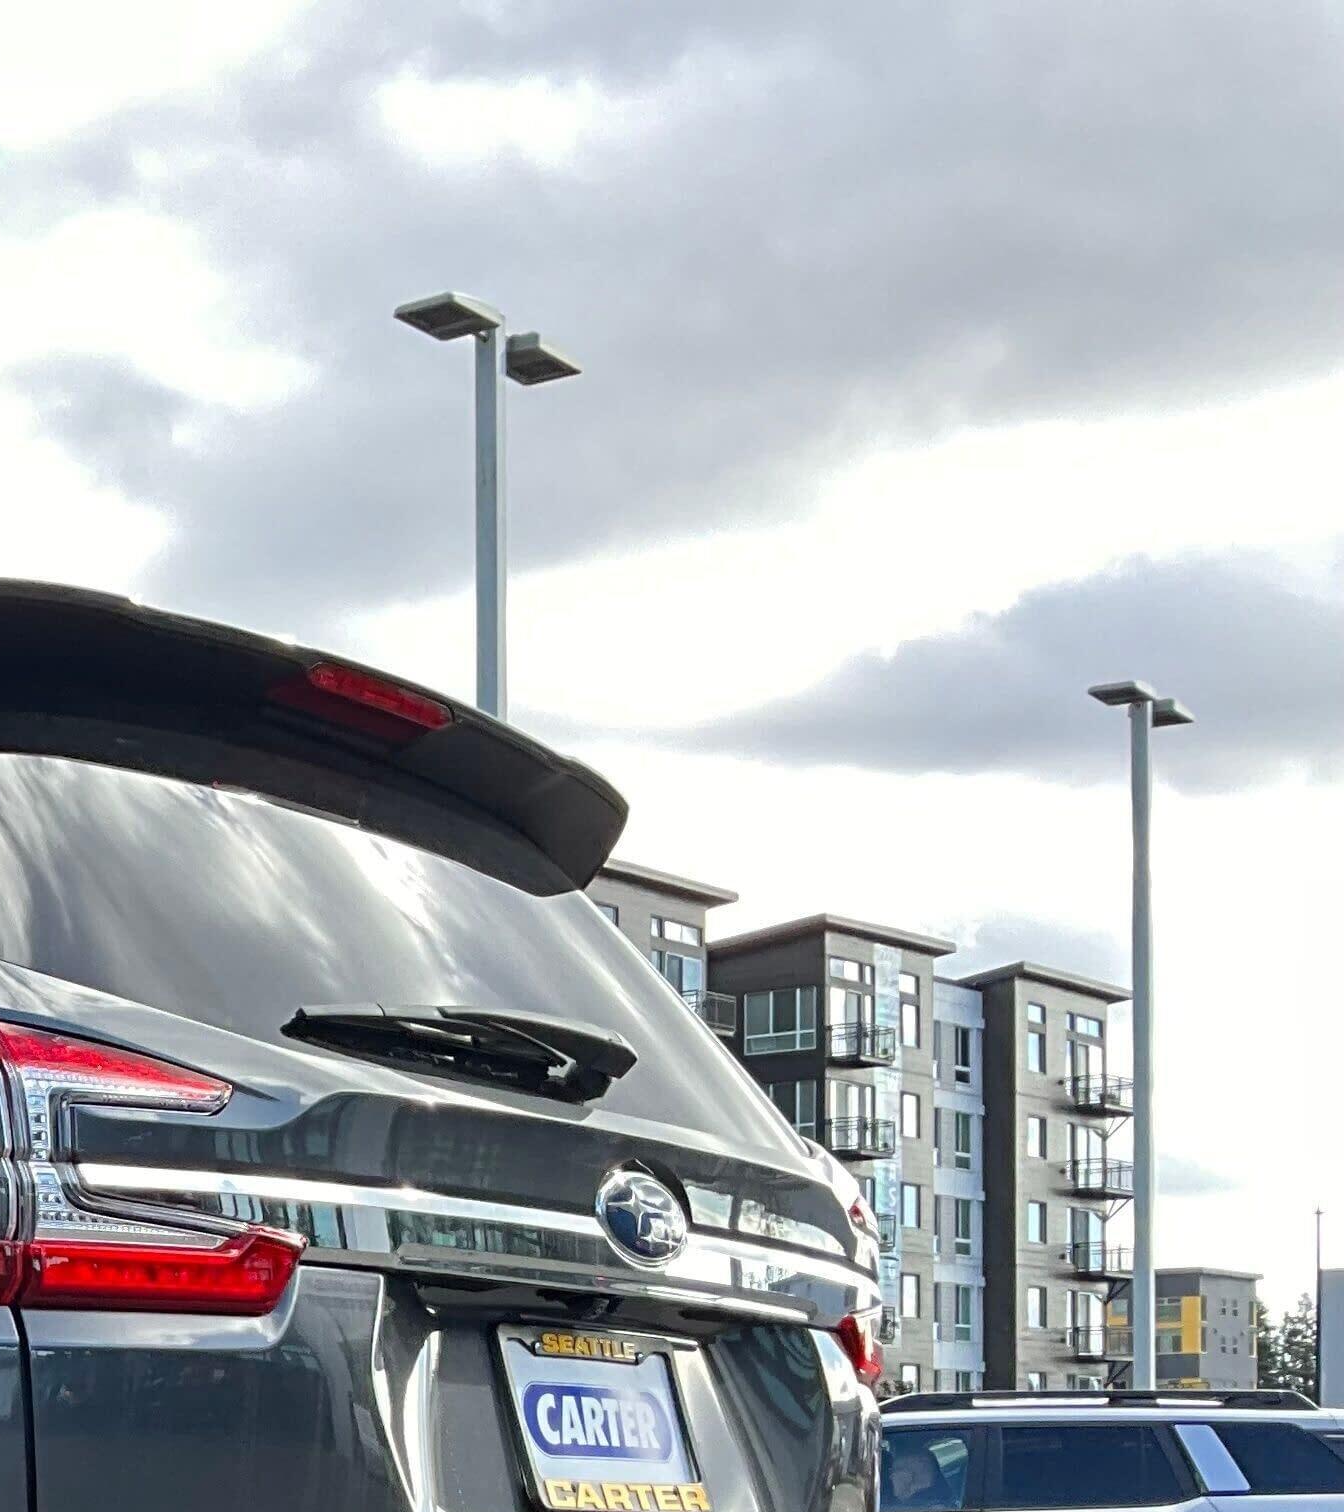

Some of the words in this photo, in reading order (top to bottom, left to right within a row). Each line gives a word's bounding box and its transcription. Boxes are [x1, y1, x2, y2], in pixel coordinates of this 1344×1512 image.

[541, 1332, 636, 1361] SEATTLE
[536, 1393, 661, 1449] CARTER
[544, 1479, 710, 1512] CARTER
